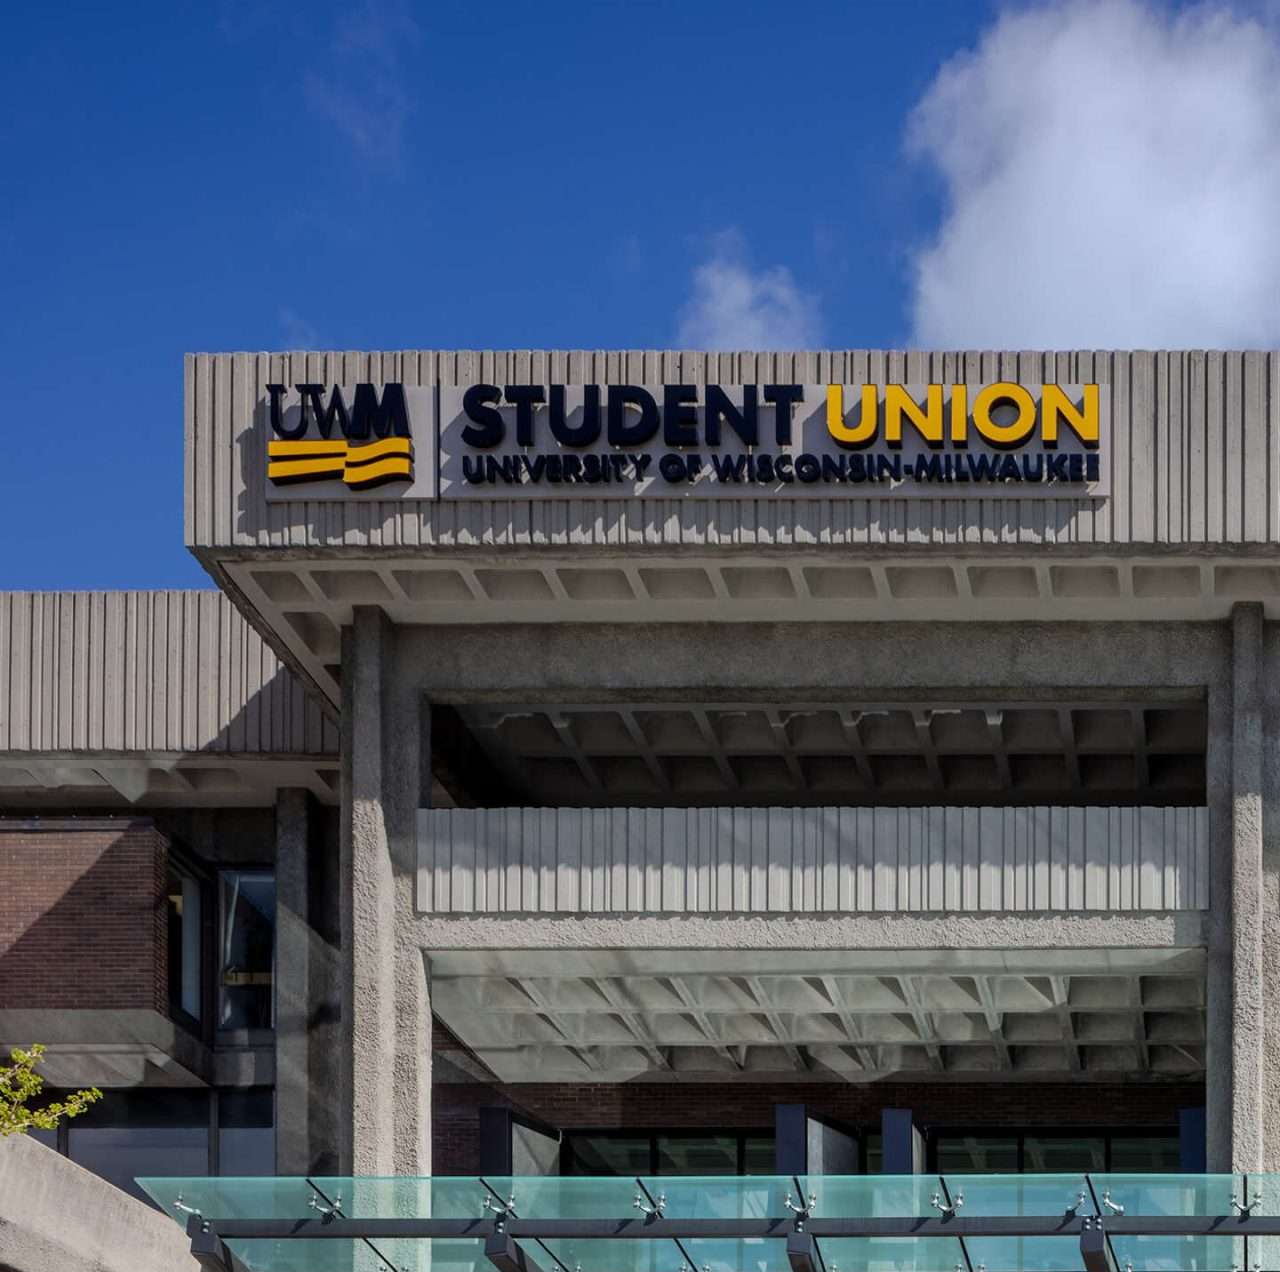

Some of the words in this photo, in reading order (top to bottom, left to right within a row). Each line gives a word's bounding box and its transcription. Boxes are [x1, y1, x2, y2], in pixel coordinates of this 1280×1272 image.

[266, 384, 413, 440] UWM
[461, 383, 805, 448] STUDENT
[826, 382, 1100, 449] UNION
[462, 453, 652, 485] UNIVERSITY
[658, 453, 701, 485] OF
[711, 453, 1100, 484] WISCONSIN-MILWAUKEE
